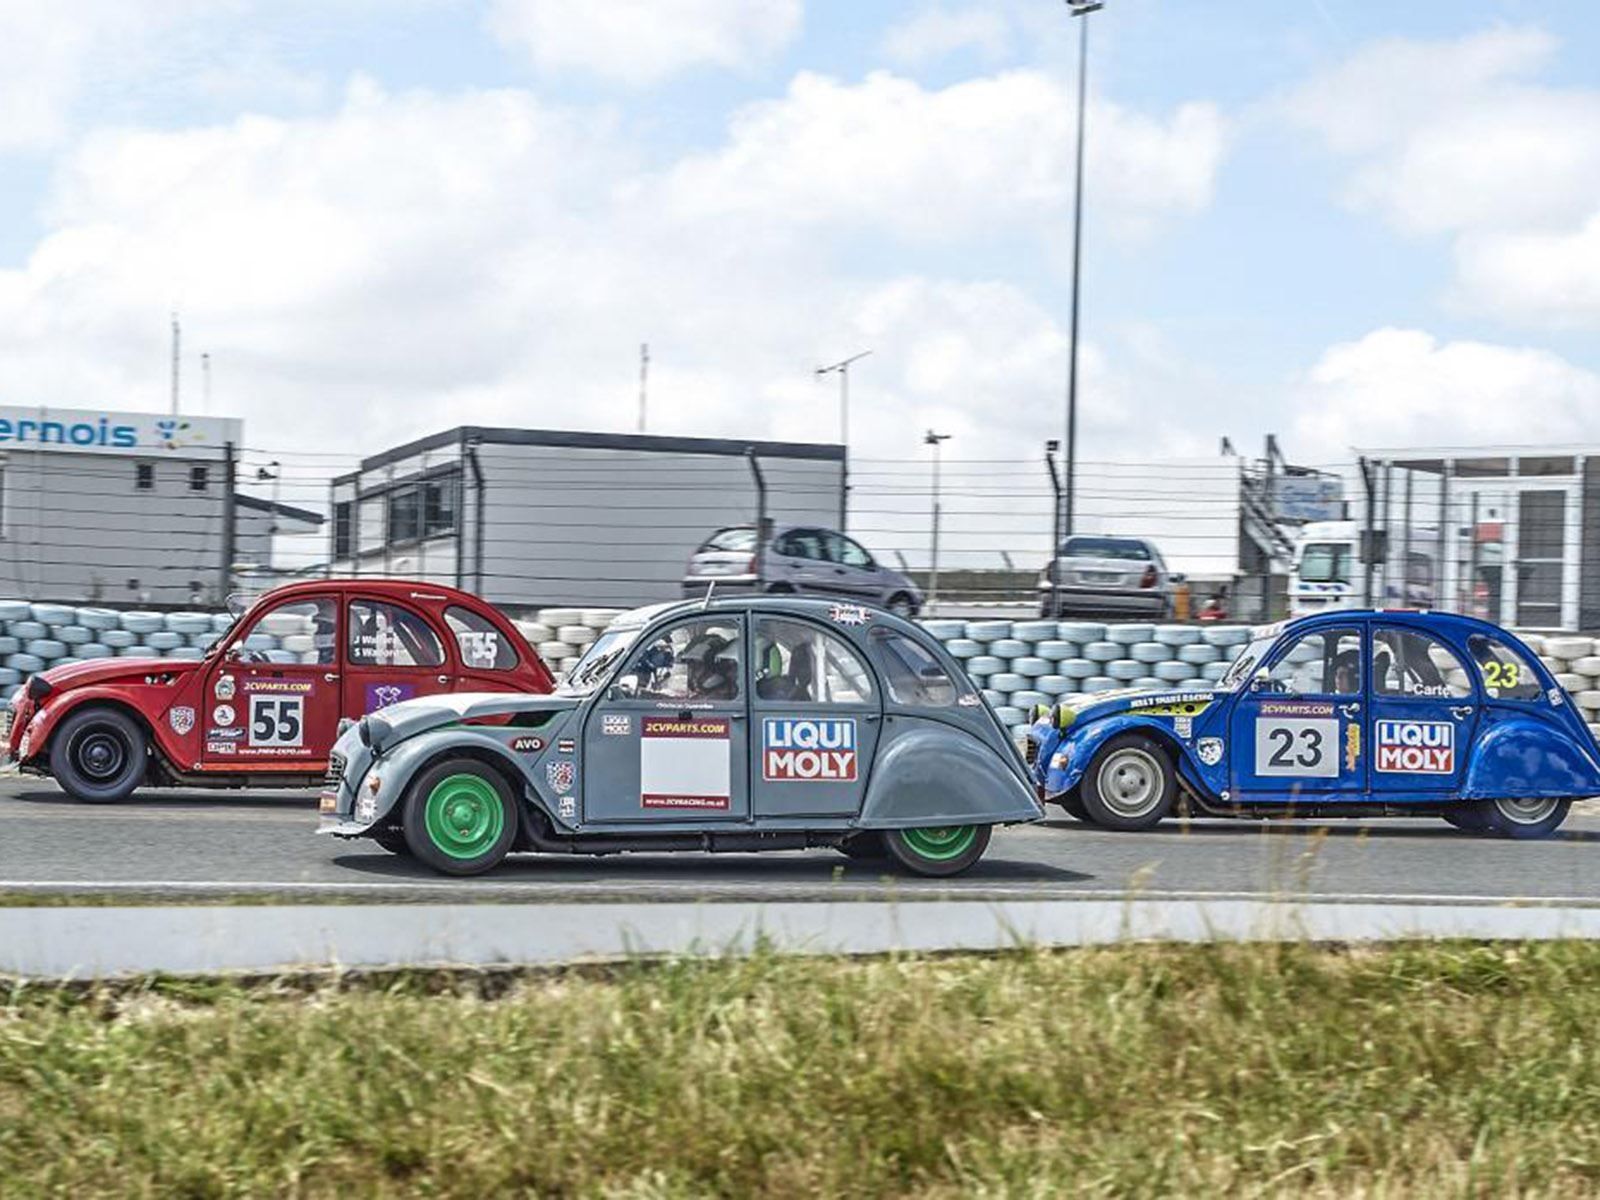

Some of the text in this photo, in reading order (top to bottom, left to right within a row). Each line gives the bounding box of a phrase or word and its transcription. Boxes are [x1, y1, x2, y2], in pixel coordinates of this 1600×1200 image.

[1483, 661, 1519, 689] 23
[254, 700, 301, 742] 55
[1261, 704, 1335, 715] 2CVPARTS.COM
[645, 723, 725, 733] 2CVPARTS.COM
[768, 721, 851, 749] LIQUI
[1380, 722, 1450, 746] LIQUI
[514, 739, 542, 749] AVO
[1268, 728, 1323, 768] 23
[768, 751, 856, 778] MOLY
[1379, 748, 1451, 770] MOLY
